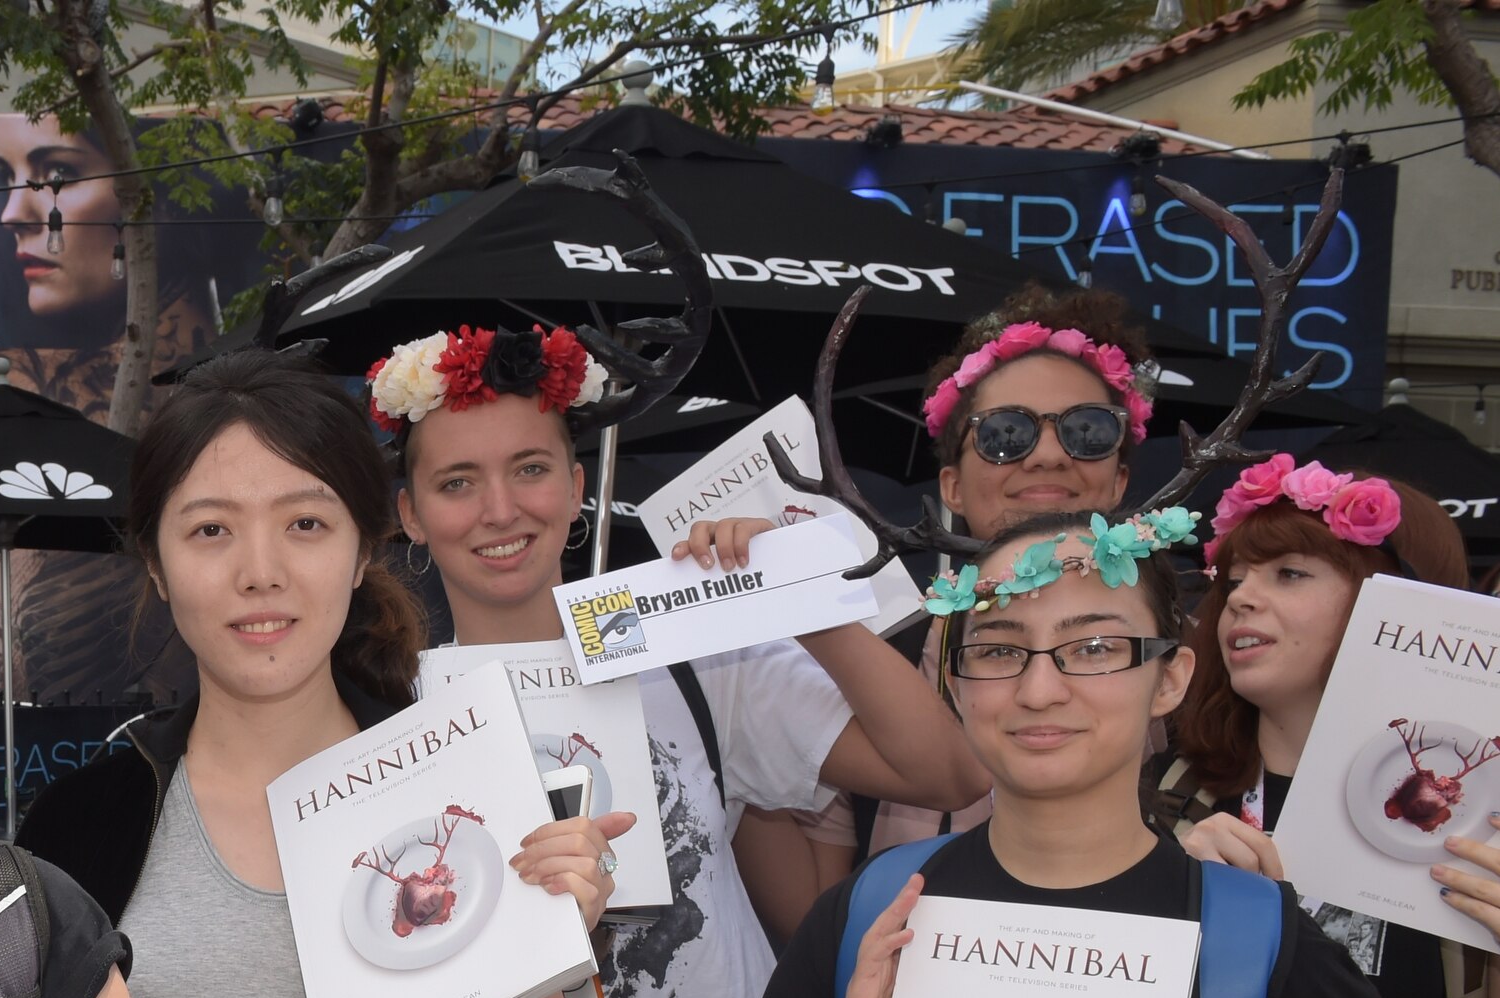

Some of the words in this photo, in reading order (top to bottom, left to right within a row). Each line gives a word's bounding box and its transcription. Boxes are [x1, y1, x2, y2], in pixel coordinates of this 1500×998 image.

[553, 241, 956, 295] BLDSPOT
[664, 433, 801, 533] HANNIBL
[567, 594, 588, 604] SAN
[594, 584, 629, 597] DIEGO
[592, 591, 634, 616] CON
[634, 584, 700, 616] Bryan
[701, 570, 764, 600] Fuller
[571, 602, 605, 656] COMIC
[1372, 620, 1500, 675] HANN
[586, 644, 649, 667] INTERNATIONAL
[293, 706, 487, 823] HANNIBAL
[343, 759, 355, 767] THE
[358, 752, 370, 761] ART
[372, 743, 387, 753] AND
[388, 730, 413, 745] MAKING
[415, 722, 423, 731] OF
[352, 799, 365, 807] THE
[369, 776, 411, 800] TELEVISION
[413, 762, 437, 777] SERIES
[1052, 930, 1082, 939] MAKING
[930, 932, 1157, 984] HANNIBAL
[989, 974, 1004, 982] THE
[1008, 976, 1056, 987] TELEVISION
[1059, 982, 1088, 991] SERIES
